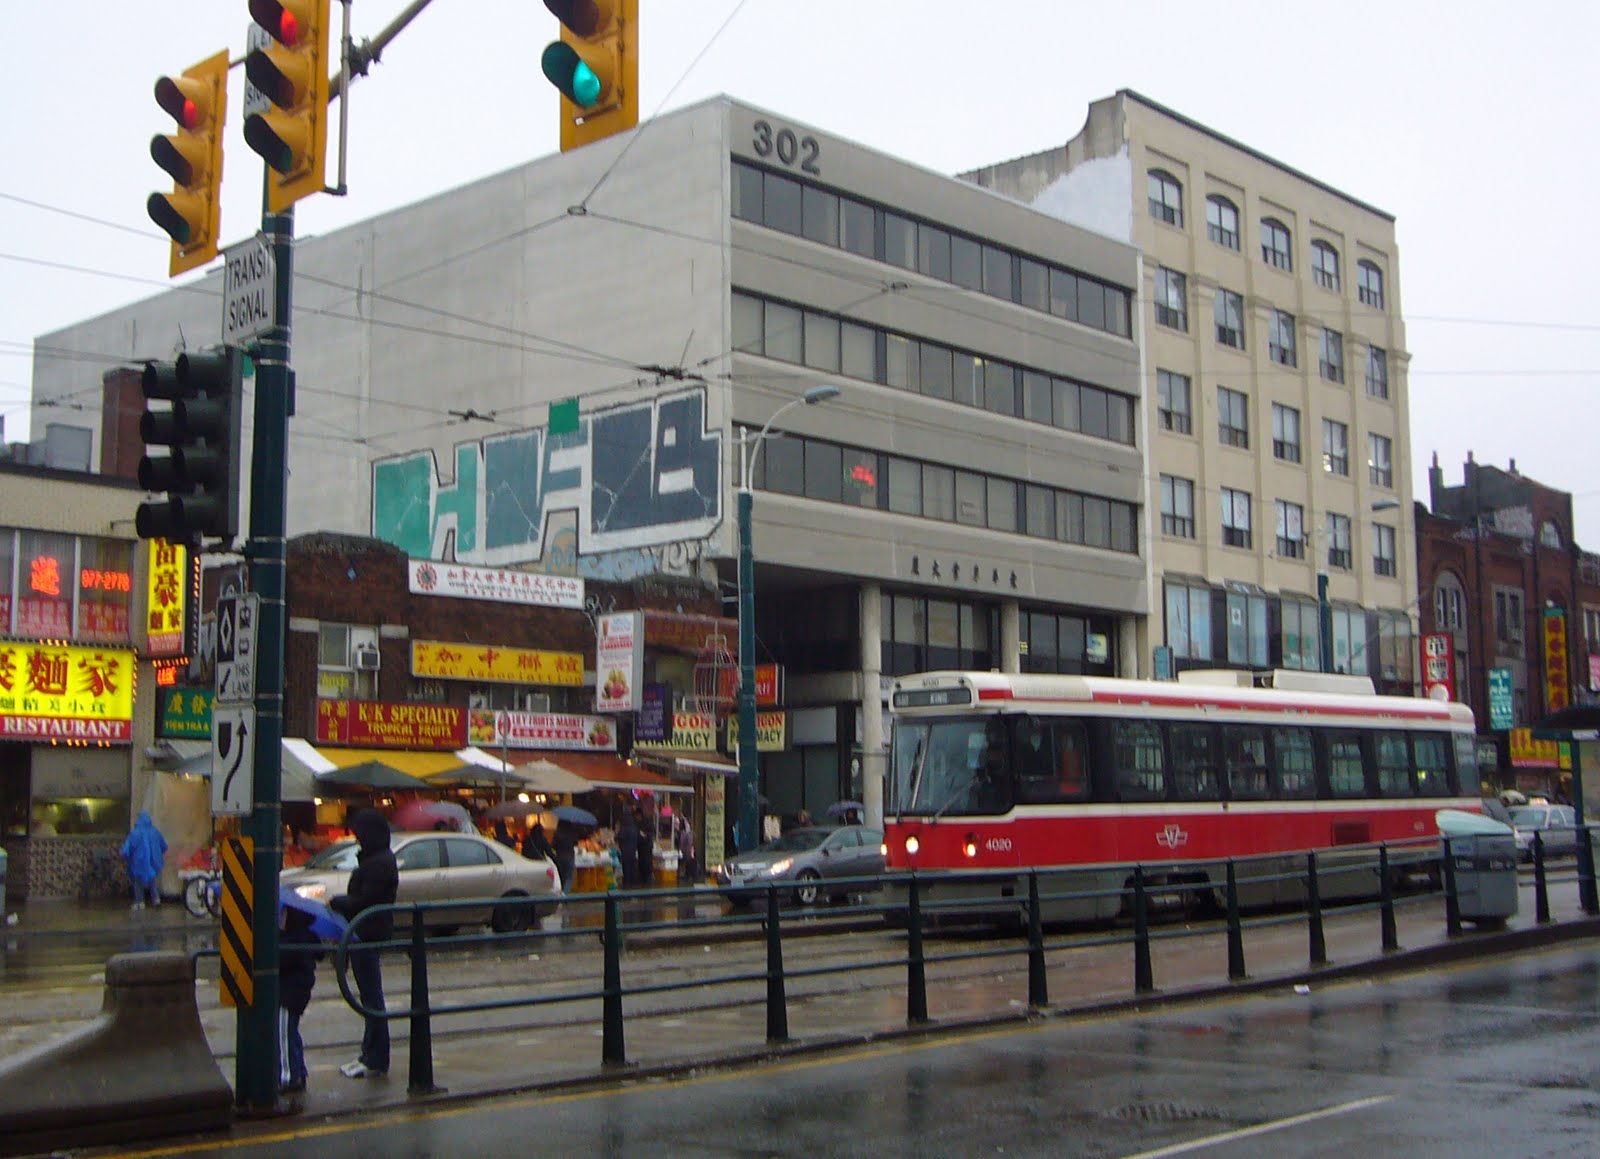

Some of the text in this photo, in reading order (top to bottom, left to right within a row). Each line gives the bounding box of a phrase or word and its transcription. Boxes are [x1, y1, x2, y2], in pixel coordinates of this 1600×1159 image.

[753, 119, 820, 175] 302
[228, 246, 270, 292] TRANSIT
[228, 289, 268, 331] SIGNAL
[390, 704, 460, 727] SPECIALTY
[672, 712, 711, 729] IGON
[3, 716, 125, 738] RESTAURANT
[367, 721, 452, 738] TROPICAL FRUITS
[985, 838, 1012, 851] 4020
